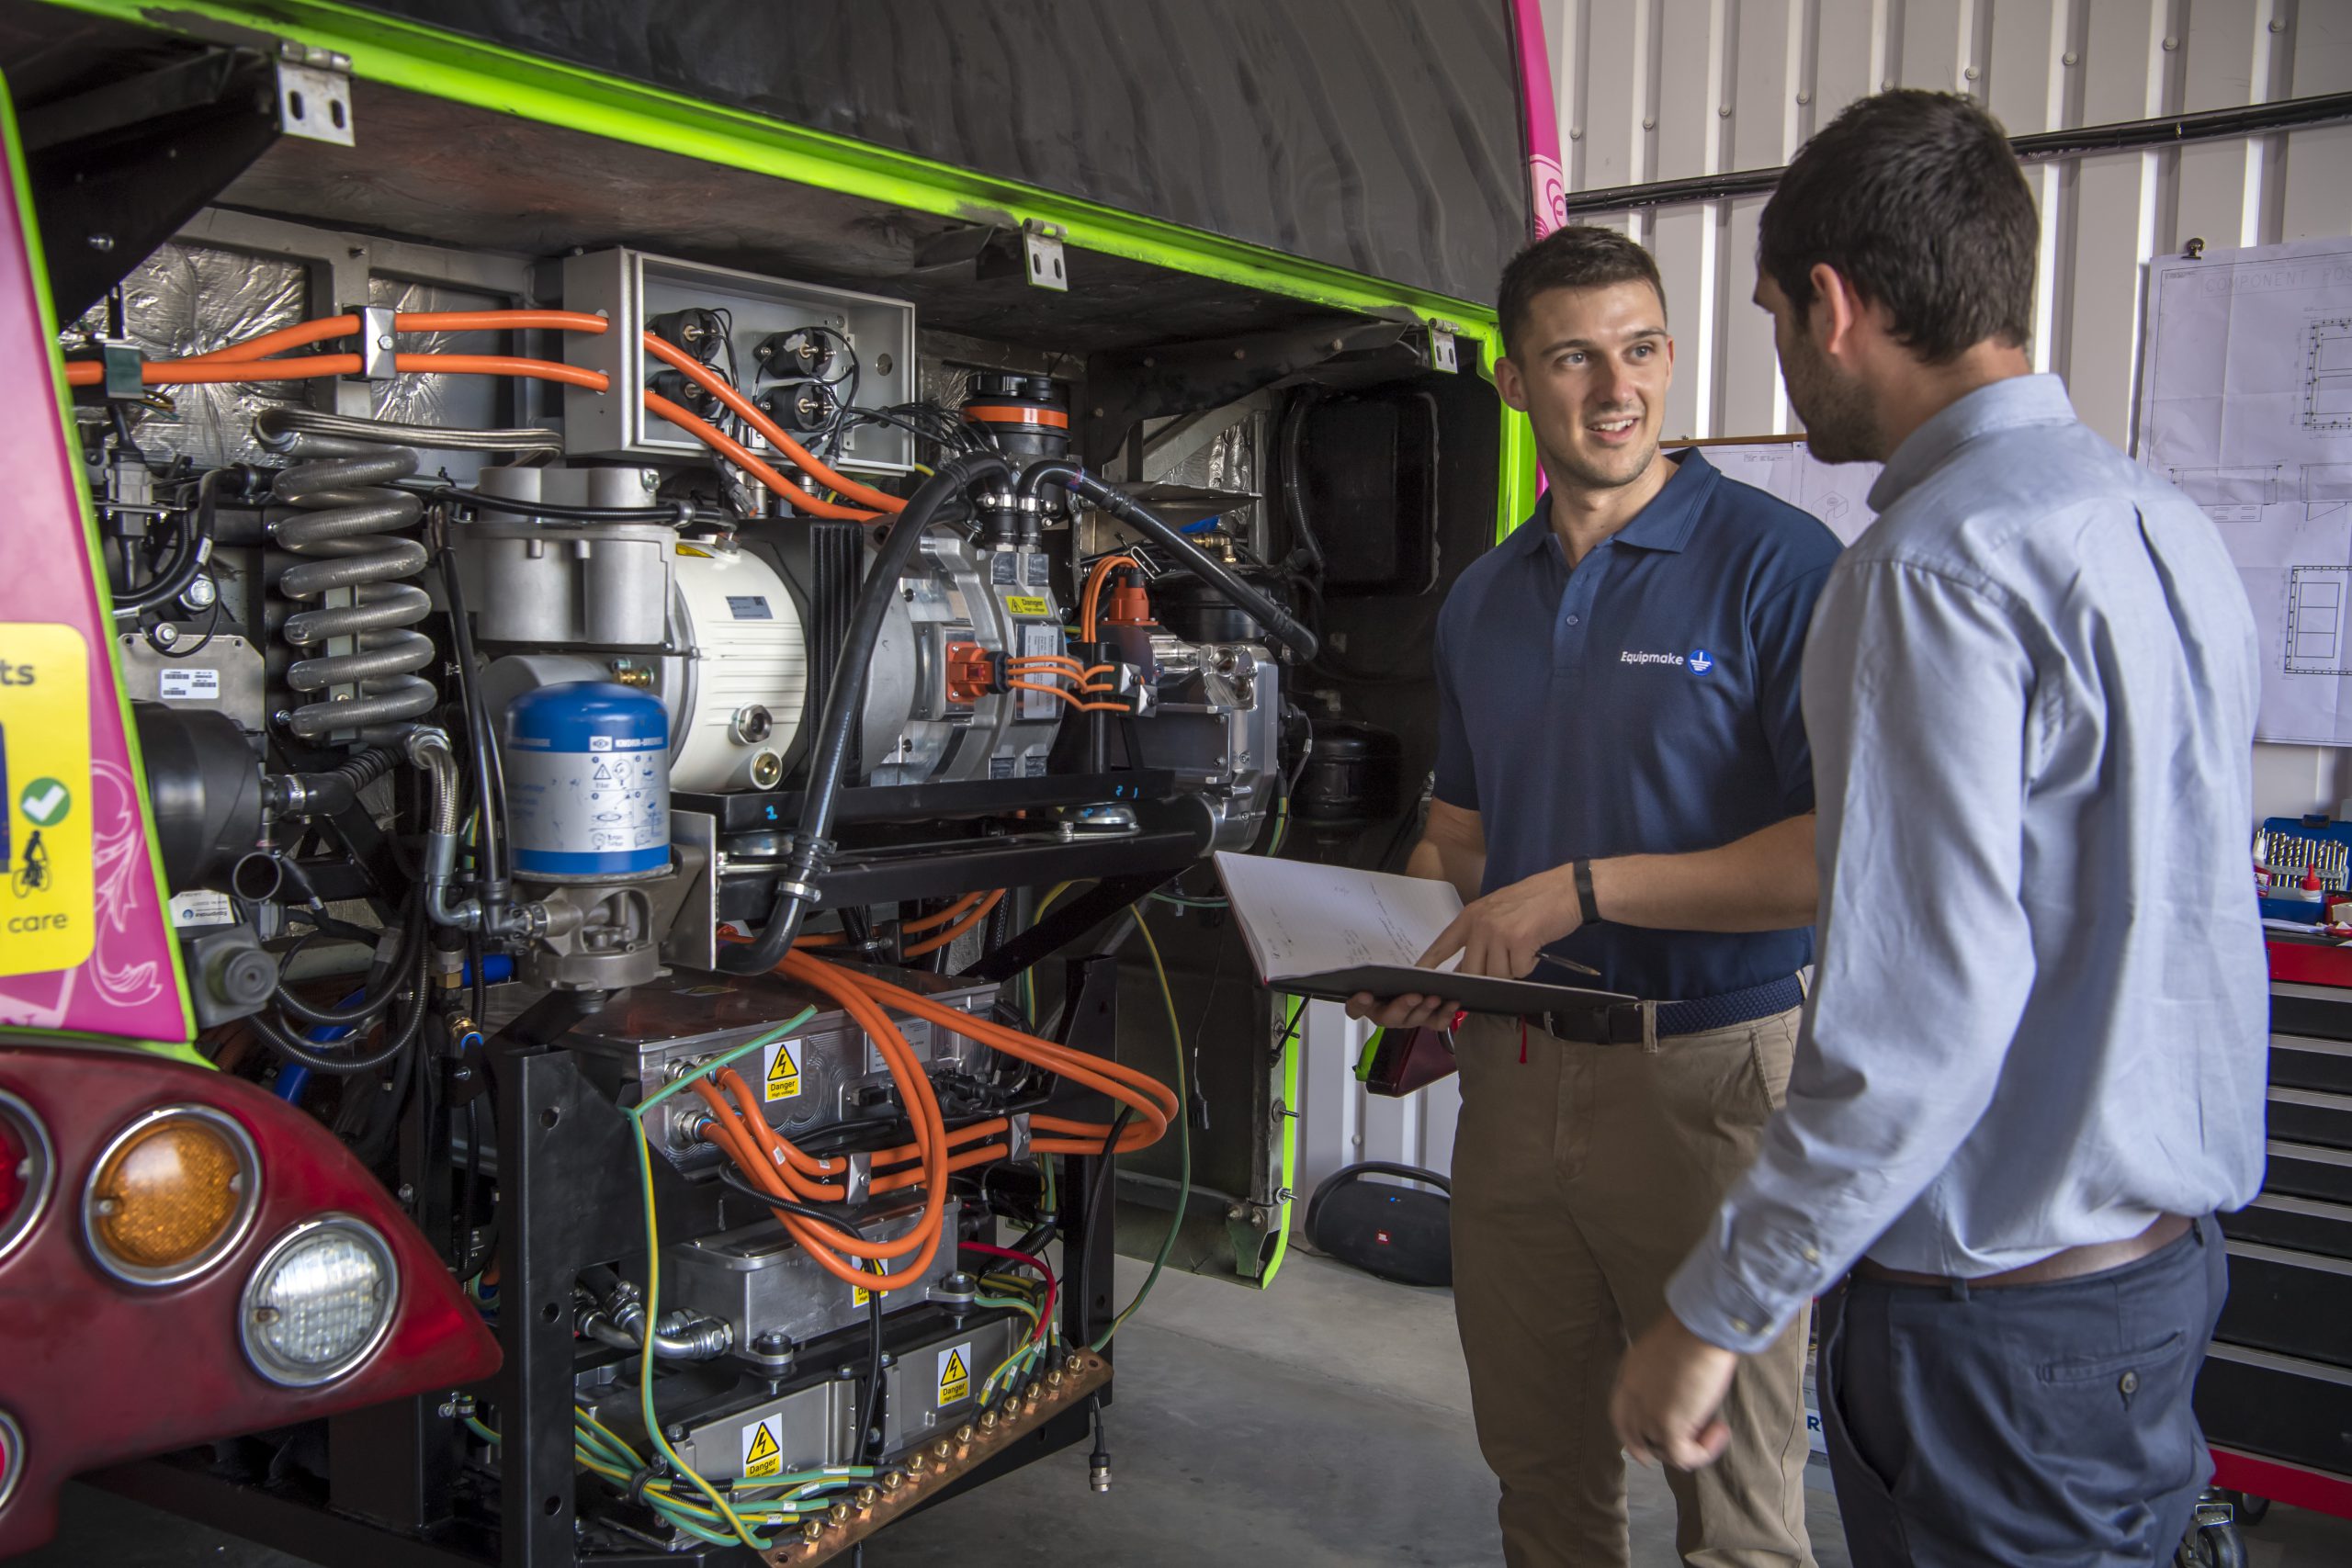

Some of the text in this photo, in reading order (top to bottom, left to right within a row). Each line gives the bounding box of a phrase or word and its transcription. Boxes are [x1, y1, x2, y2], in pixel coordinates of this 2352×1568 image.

[1021, 599, 1043, 607] Danger
[1621, 651, 1684, 665] Equipmake
[765, 806, 778, 820] 1
[7, 913, 69, 934] care
[770, 1081, 796, 1091] Danger
[943, 1382, 965, 1396] Danger
[750, 1458, 776, 1474] Danger
